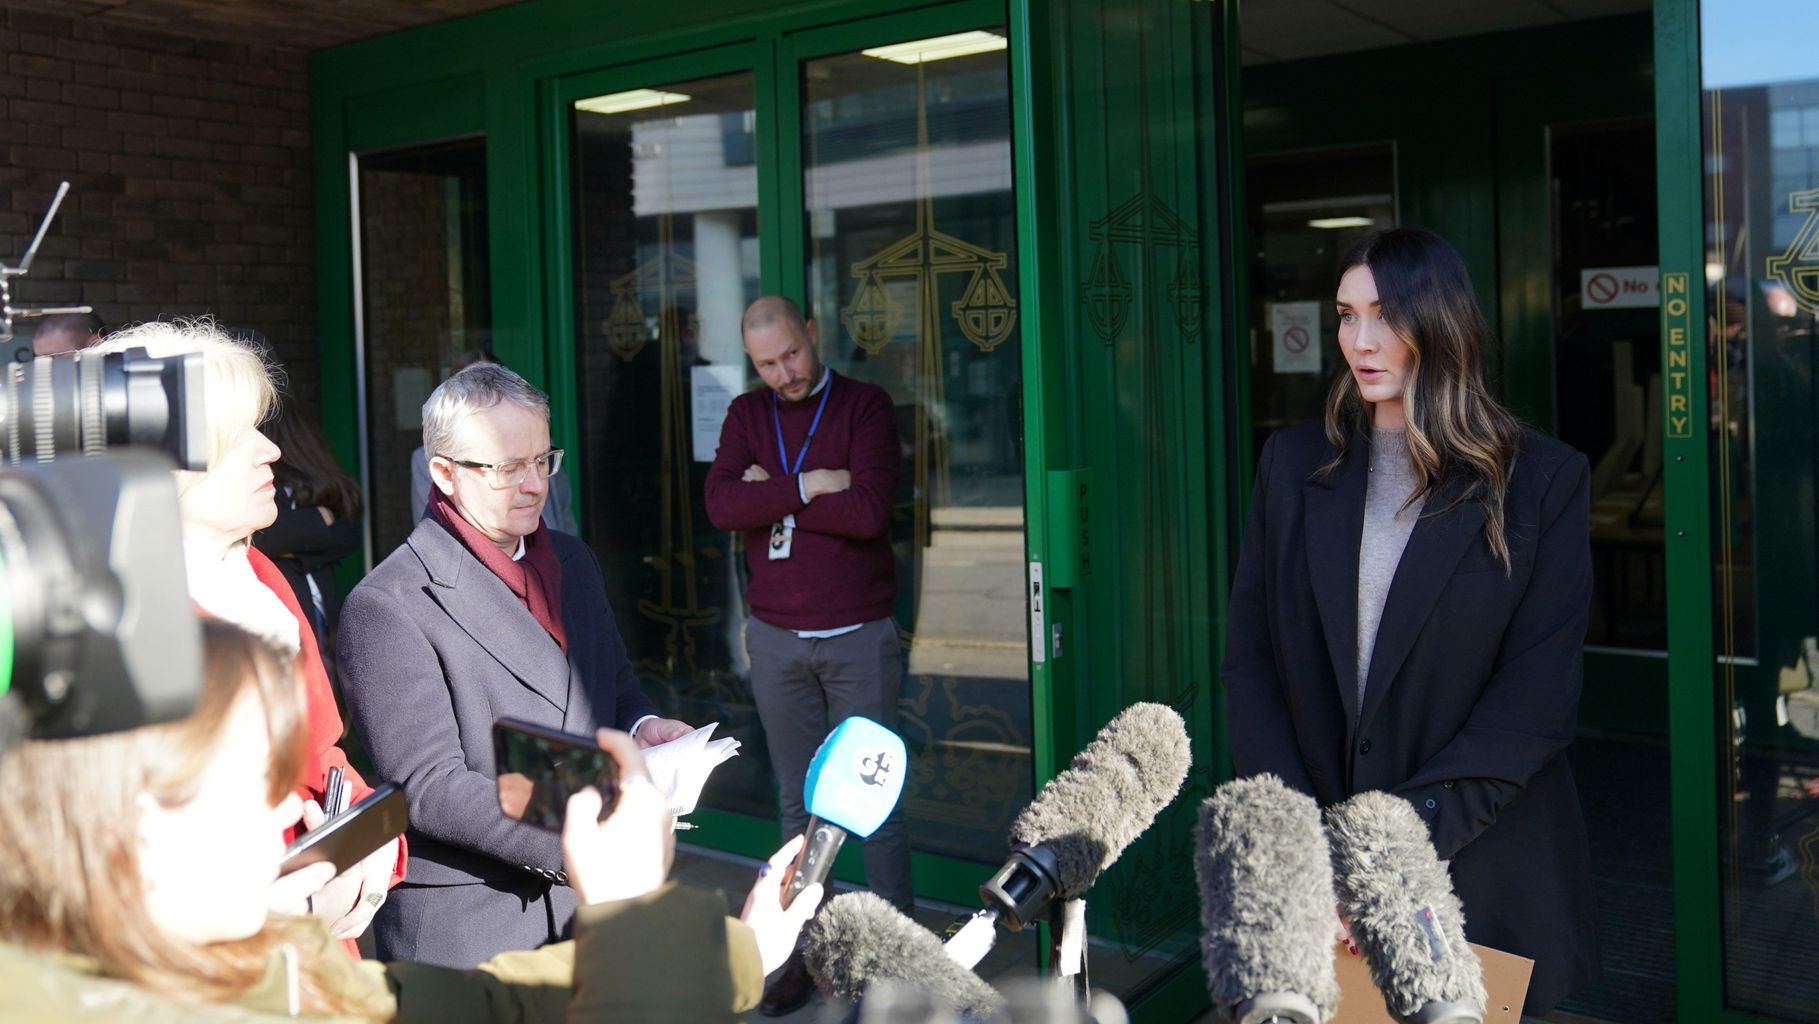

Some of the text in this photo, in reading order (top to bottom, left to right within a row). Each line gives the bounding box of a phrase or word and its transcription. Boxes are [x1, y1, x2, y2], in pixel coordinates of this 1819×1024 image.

[1623, 279, 1649, 294] No
[1667, 276, 1687, 433] NO ENTRY
[1080, 482, 1090, 569] PUSH
